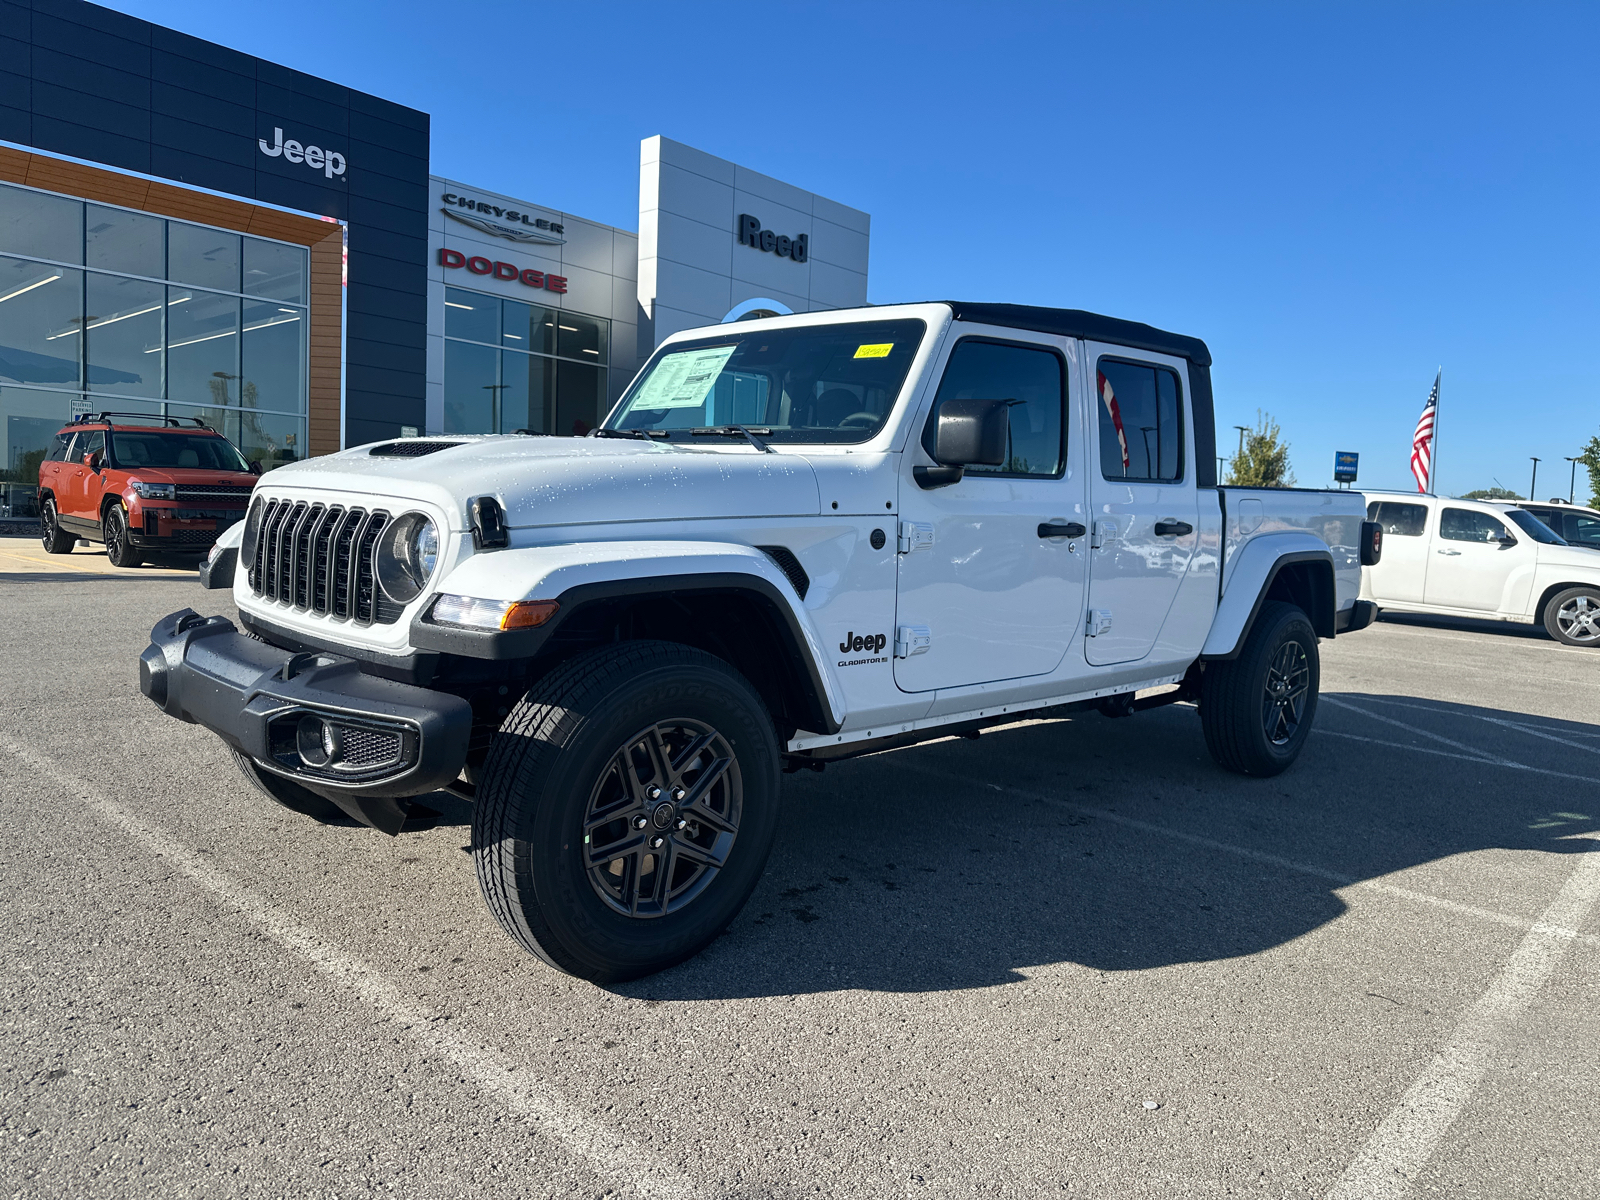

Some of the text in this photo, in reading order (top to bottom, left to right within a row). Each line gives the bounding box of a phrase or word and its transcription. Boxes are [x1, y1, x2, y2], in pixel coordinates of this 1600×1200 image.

[258, 127, 346, 179] Jeep
[442, 193, 565, 234] CHRYSLER
[739, 214, 808, 263] Reed
[439, 248, 568, 294] DODGE
[837, 657, 881, 667] GLADIATOR
[839, 631, 887, 654] Jeep
[609, 682, 770, 761] BRIDGESTONE
